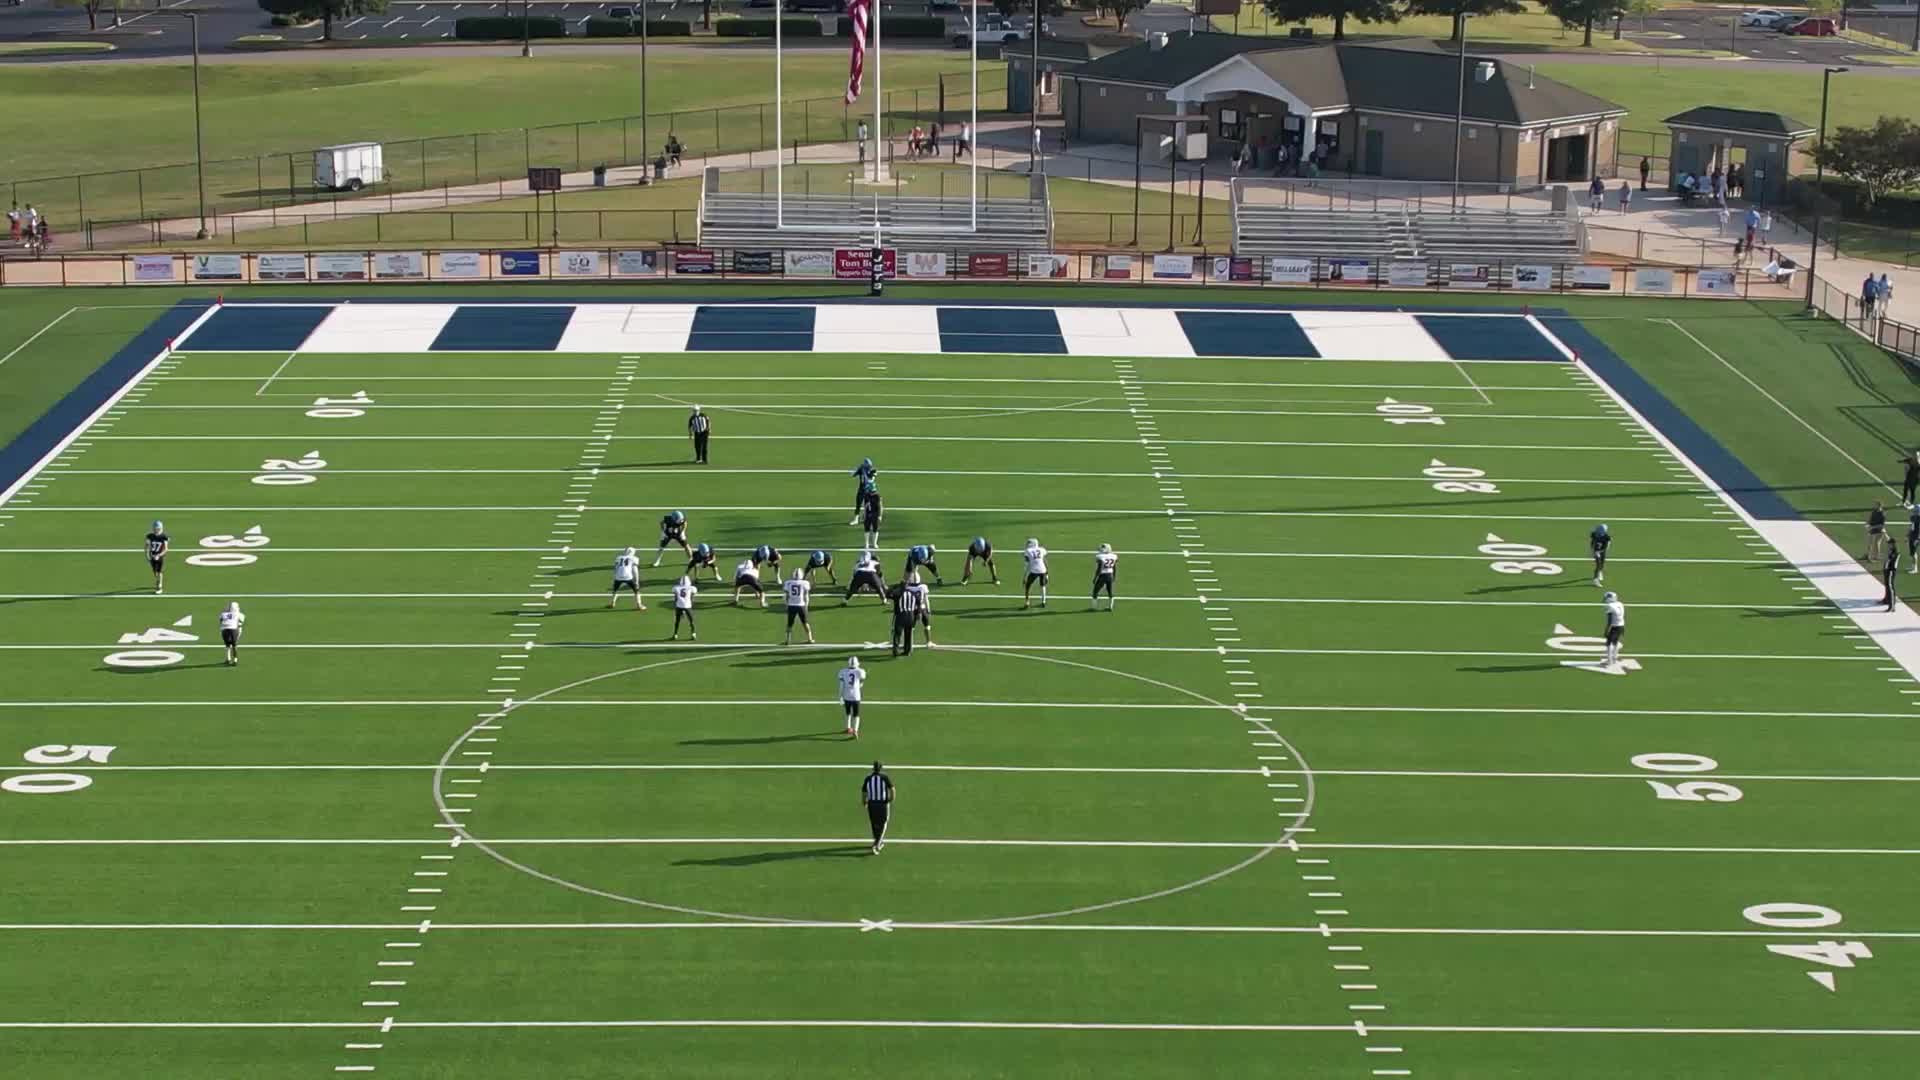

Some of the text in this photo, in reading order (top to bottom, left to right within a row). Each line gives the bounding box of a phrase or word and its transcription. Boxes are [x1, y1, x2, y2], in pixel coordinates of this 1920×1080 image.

[840, 259, 860, 267] Tom
[847, 251, 872, 259] Senat
[305, 396, 375, 418] 10
[1376, 403, 1446, 425] 10
[251, 458, 327, 485] 20
[1423, 466, 1500, 494] 20
[185, 535, 270, 566] 30
[1478, 543, 1563, 575] 30
[103, 628, 199, 667] 40
[1545, 636, 1643, 675] 40
[848, 673, 856, 686] 3
[0, 745, 117, 794] 50
[1631, 753, 1744, 802] 50
[1742, 902, 1873, 968] 40
